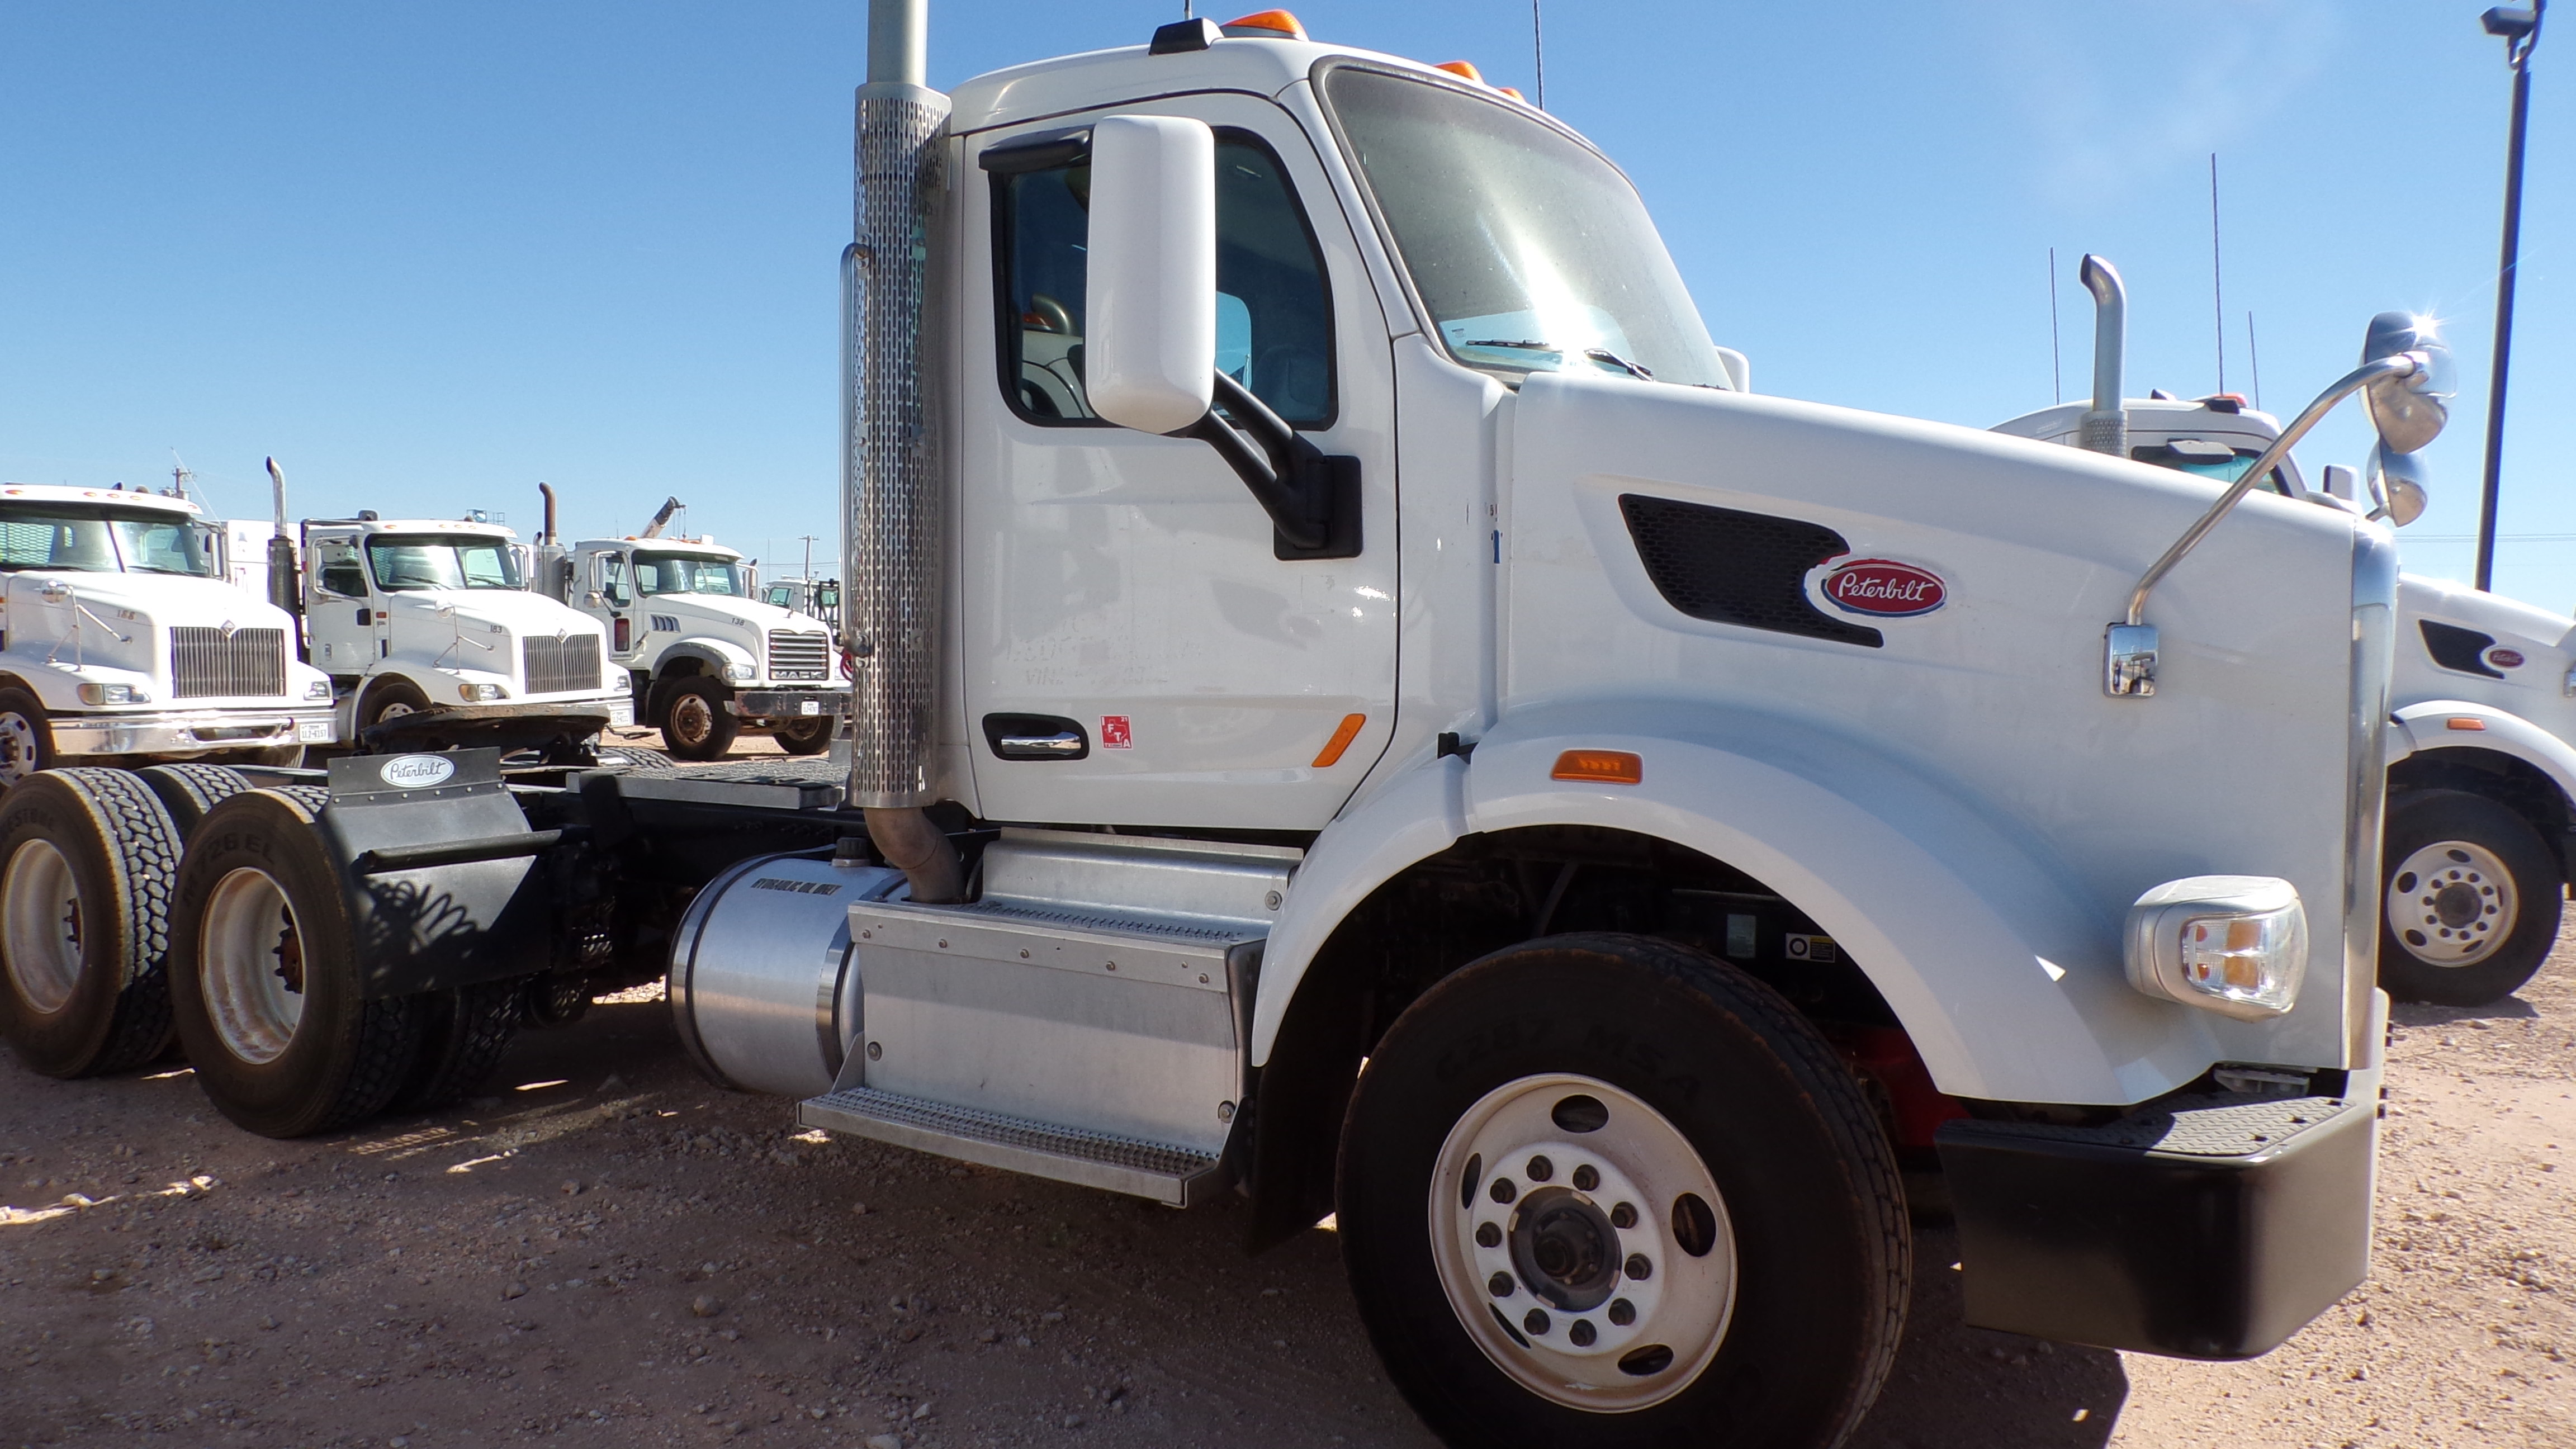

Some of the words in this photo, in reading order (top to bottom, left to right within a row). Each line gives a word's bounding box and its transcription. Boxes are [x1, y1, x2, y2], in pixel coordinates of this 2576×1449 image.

[1838, 572, 1935, 601] Peterbilt
[490, 624, 502, 633] 183
[732, 617, 745, 626] 138
[390, 762, 447, 780] Peterbilt
[750, 878, 803, 892] HYDRAULIC
